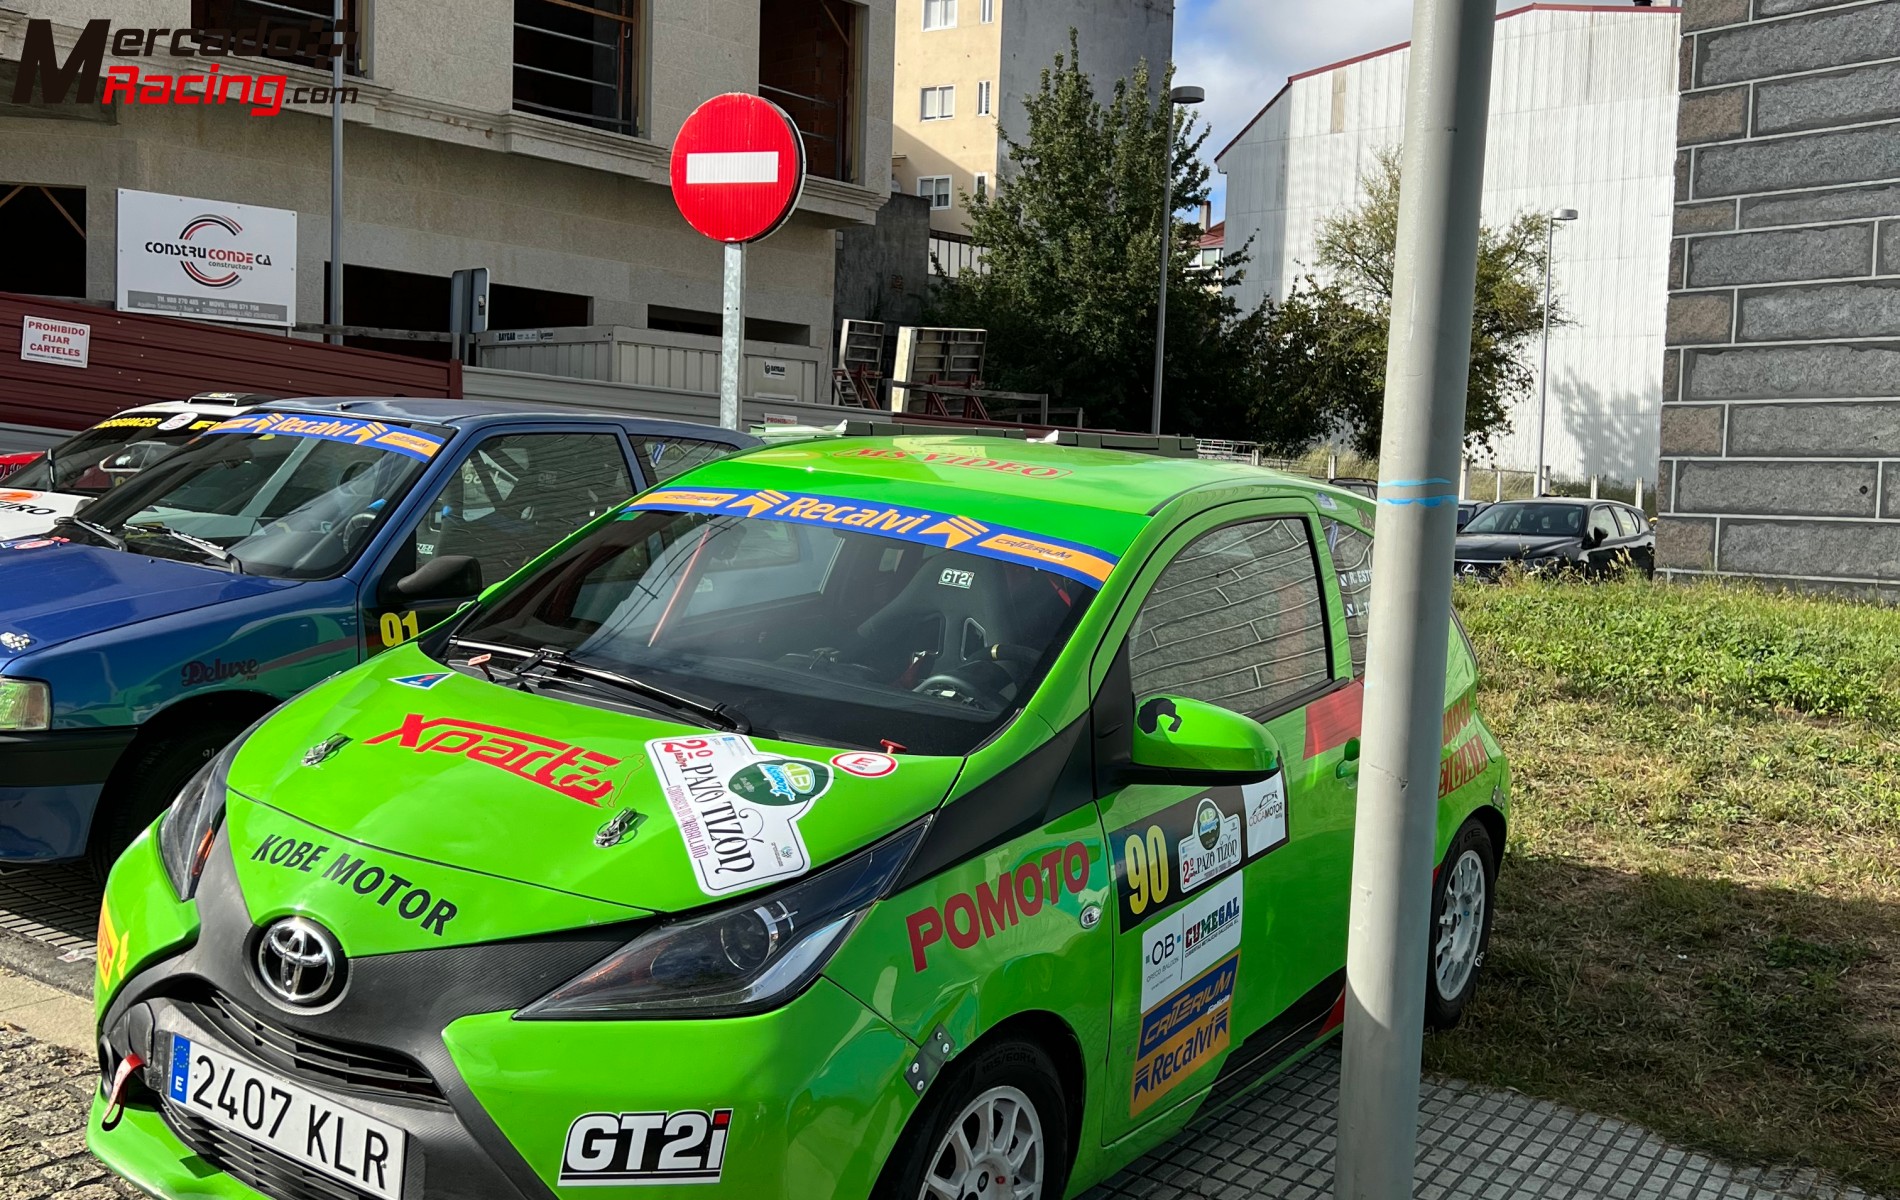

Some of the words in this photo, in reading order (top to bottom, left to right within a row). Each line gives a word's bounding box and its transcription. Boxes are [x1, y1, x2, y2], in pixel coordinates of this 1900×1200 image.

[208, 260, 254, 271] constructora
[28, 320, 85, 336] PROHIBIDO
[42, 333, 70, 345] FIJAR
[30, 342, 80, 357] CARTELES
[270, 417, 358, 437] Recalvi
[923, 453, 1059, 478] VIDEO
[775, 497, 931, 534] Recalvi
[940, 568, 974, 588] GT2i
[181, 657, 260, 687] Deluxe
[681, 763, 727, 803] PAZO
[1124, 825, 1170, 915] 90
[1196, 852, 1216, 875] PAZO
[251, 834, 331, 873] KOBE
[321, 852, 459, 938] MOTOR
[906, 840, 1091, 974] POMOTO
[1185, 896, 1240, 949] CUMEGAL
[1151, 933, 1175, 966] OB
[1144, 970, 1233, 1046] CRITERIUM
[1150, 1016, 1216, 1091] Recalvi
[174, 1076, 184, 1092] E
[192, 1055, 293, 1139] 2407
[306, 1104, 390, 1190] KLR
[564, 1110, 730, 1171] GT2i
